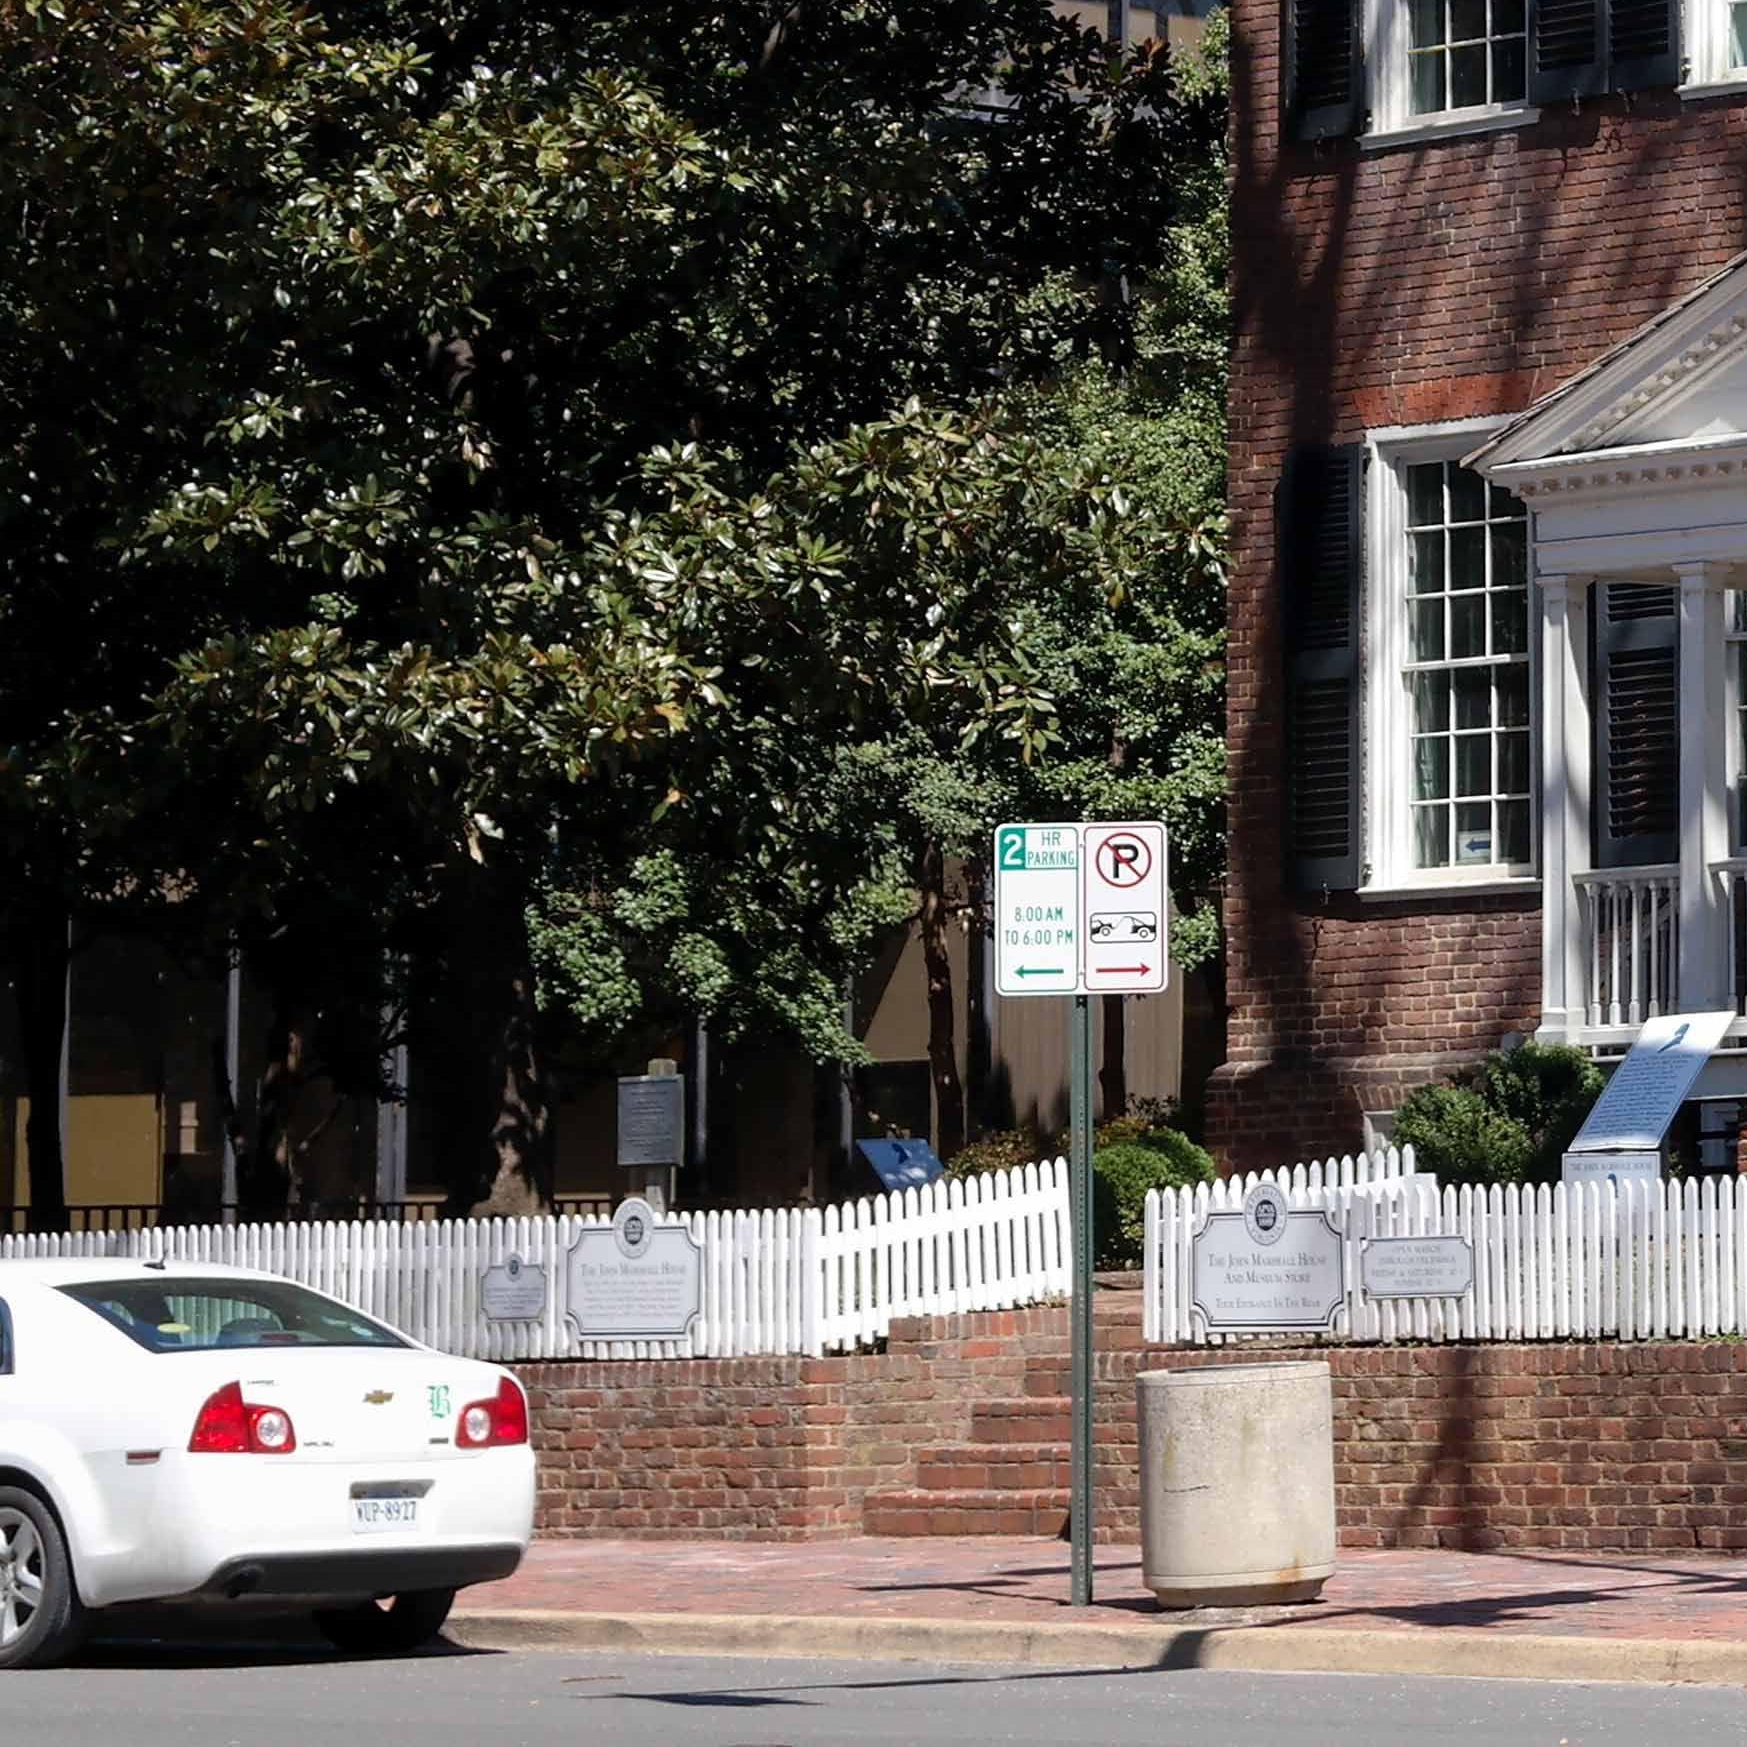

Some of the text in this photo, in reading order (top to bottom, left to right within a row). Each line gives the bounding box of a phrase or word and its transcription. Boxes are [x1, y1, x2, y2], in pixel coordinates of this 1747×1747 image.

[1040, 831, 1061, 846] HR
[1002, 833, 1023, 866] 2
[1027, 851, 1075, 866] PARKING
[1045, 907, 1064, 922] AM
[1005, 930, 1074, 945] TO 6:00 PM
